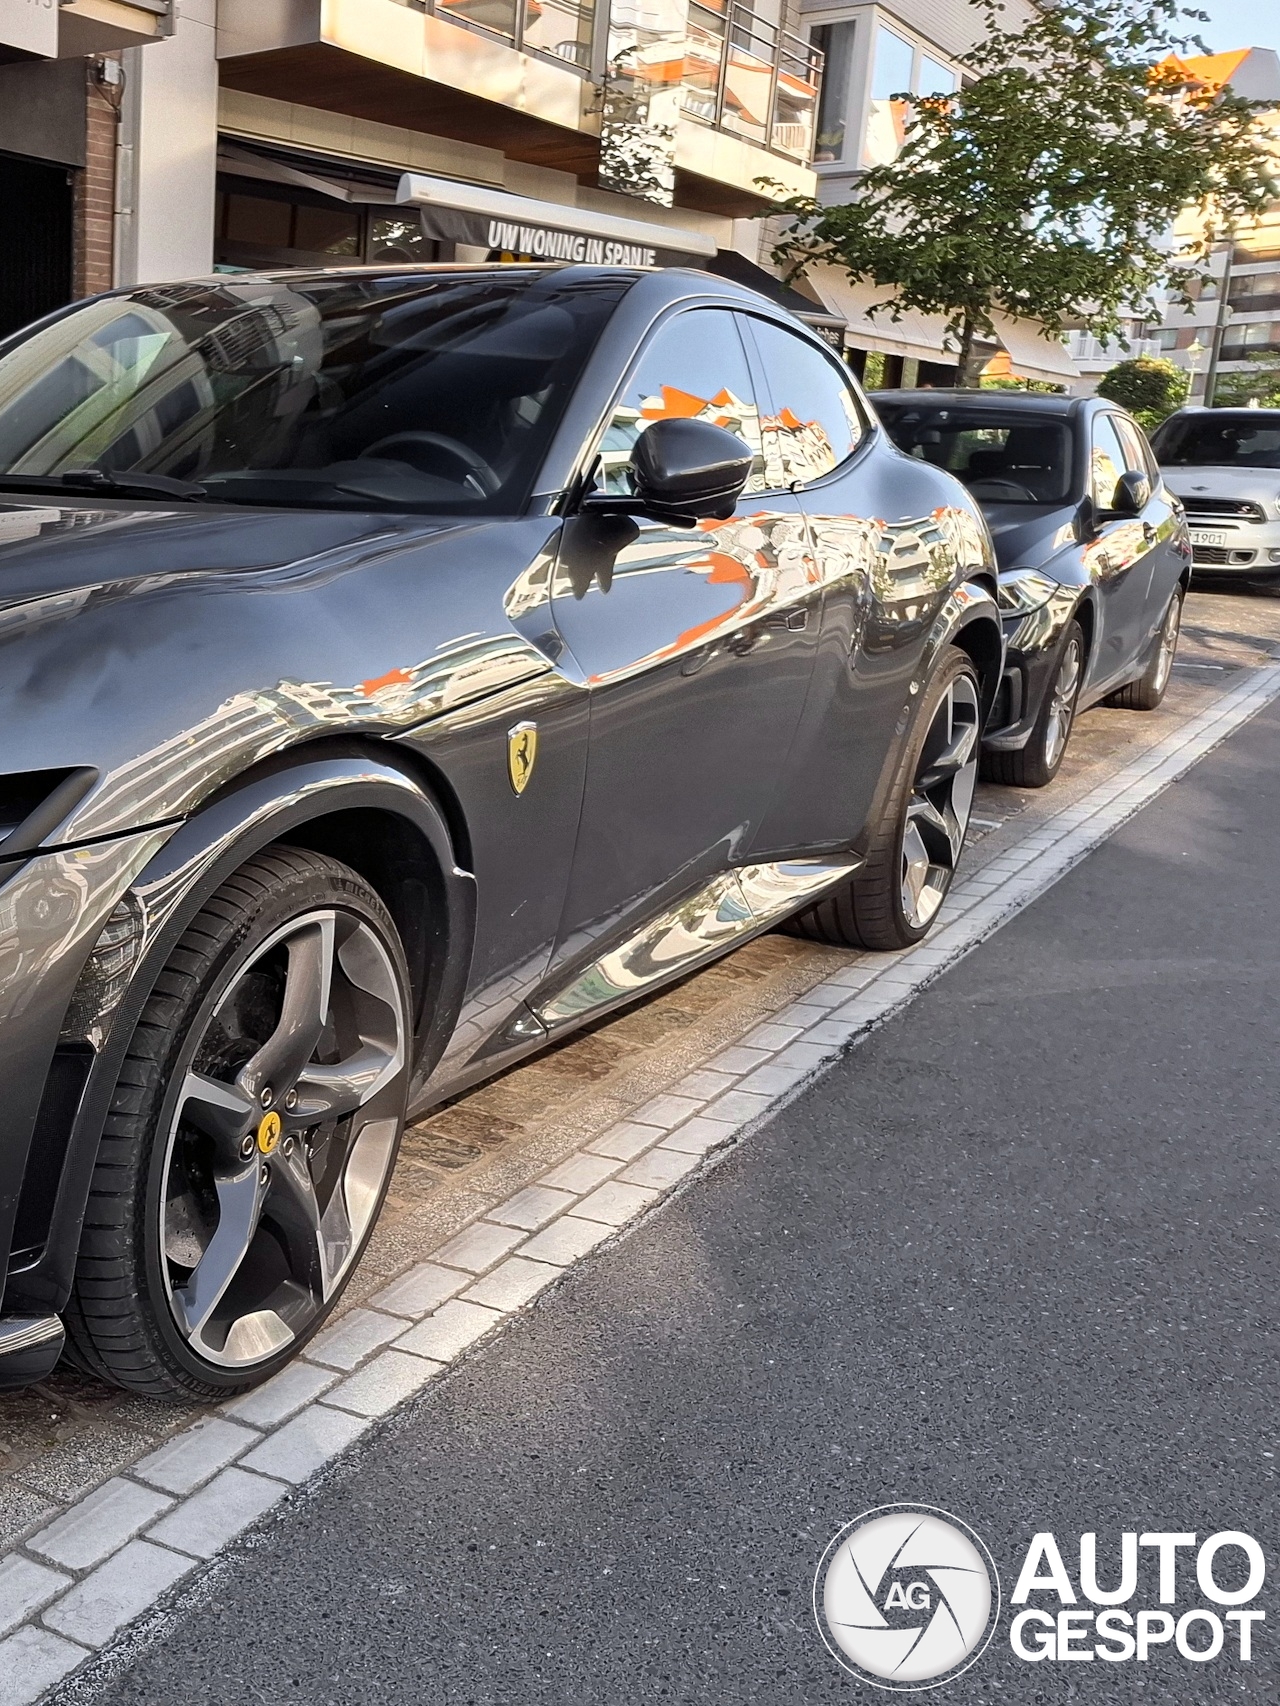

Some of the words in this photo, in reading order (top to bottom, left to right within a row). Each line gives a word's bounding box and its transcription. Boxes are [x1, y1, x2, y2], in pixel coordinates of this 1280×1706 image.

[488, 220, 519, 251] UW
[519, 226, 586, 262] WONING
[585, 238, 605, 264] IN
